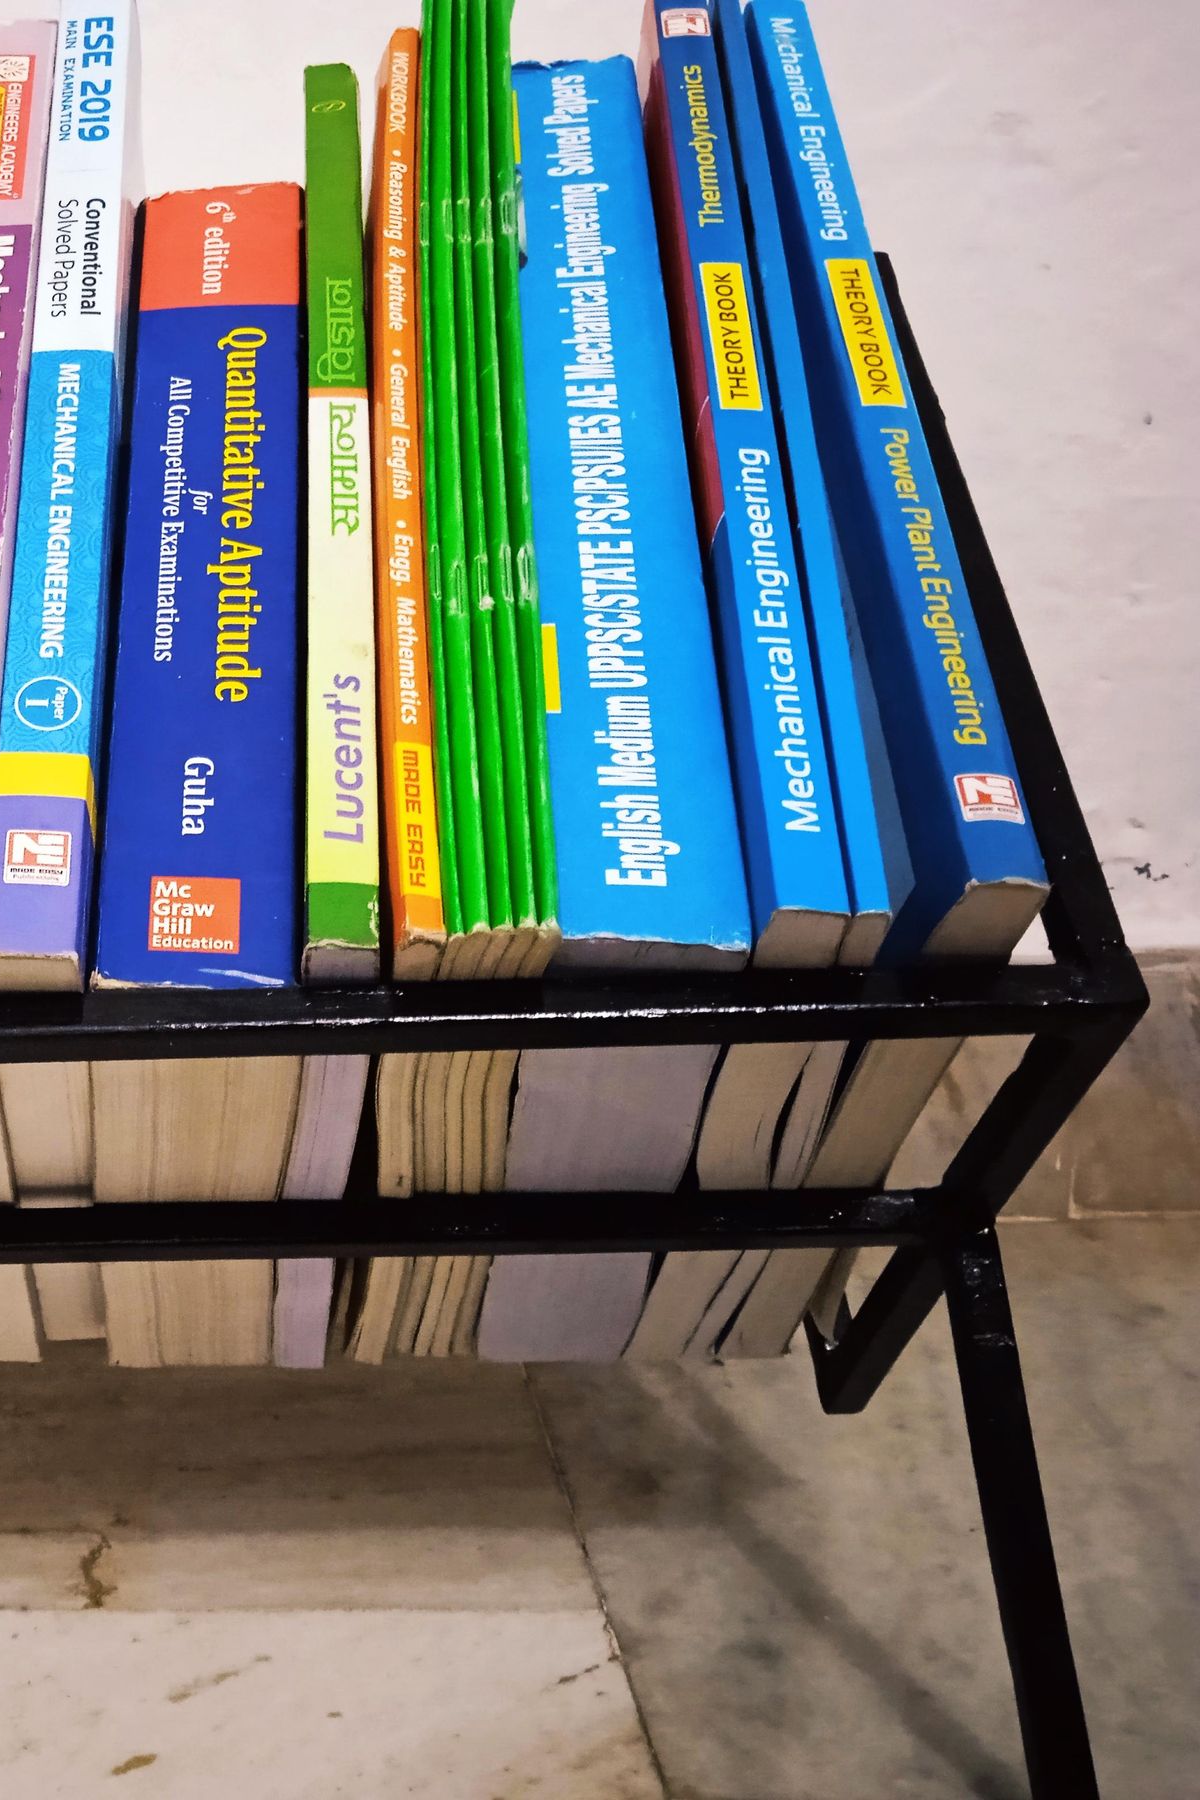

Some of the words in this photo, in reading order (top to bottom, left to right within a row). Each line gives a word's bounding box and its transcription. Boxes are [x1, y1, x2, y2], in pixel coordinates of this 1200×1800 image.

[64, 20, 78, 50] MAIN
[82, 16, 114, 68] ESE
[3, 83, 23, 142] ENGINEERS
[58, 58, 76, 142] EXAMINATION
[78, 79, 111, 142] 2019
[389, 51, 409, 134] WORKBOOK
[543, 75, 599, 125] Papers
[544, 126, 595, 176] Solved
[680, 64, 724, 228] Thermodynamics
[799, 125, 848, 241] Engineering
[55, 199, 79, 257] Solved
[205, 200, 238, 223] 6th
[384, 160, 408, 241] Reasoning
[550, 183, 617, 278] Engineering
[80, 198, 106, 315] Conventional
[202, 227, 230, 295] edition
[389, 245, 406, 257] &
[47, 261, 75, 318] Papers
[387, 262, 408, 332] Aptitude
[712, 271, 739, 322] BOOK
[316, 276, 356, 383] विज्ञान
[557, 280, 616, 380] Mechanical
[719, 323, 746, 400] THEORY
[840, 268, 877, 340] THEORY
[860, 343, 892, 396] BOOK
[169, 375, 192, 401] All
[389, 363, 411, 430] General
[565, 384, 619, 409] AE
[50, 363, 81, 500] MECHANICAL
[159, 404, 191, 517] Competitive
[217, 326, 267, 529] Quantitative
[880, 427, 920, 502] Power
[188, 487, 213, 515] for
[329, 401, 360, 536] सामान्य
[387, 436, 413, 501] English
[389, 533, 414, 587] Engg.
[735, 447, 790, 630] Engineering
[901, 507, 941, 572] Plant
[39, 505, 72, 659] ENGINEERING
[153, 521, 185, 662] Examinations
[206, 536, 264, 703] Aptitude
[578, 541, 649, 689] UPPSC/STATE
[396, 597, 418, 725] Mathematics
[920, 576, 989, 747] Engineering
[54, 685, 69, 720] Paper
[757, 636, 821, 833] Mechanical
[323, 673, 364, 844] Lucent's
[594, 696, 657, 787] Medium
[181, 755, 215, 836] Guha
[401, 749, 422, 814] MADE
[406, 825, 426, 887] EASY
[599, 794, 681, 887] English
[153, 898, 215, 917] Graw
[153, 916, 192, 935] Hill
[155, 880, 192, 898] Mc
[152, 935, 234, 950] Education
